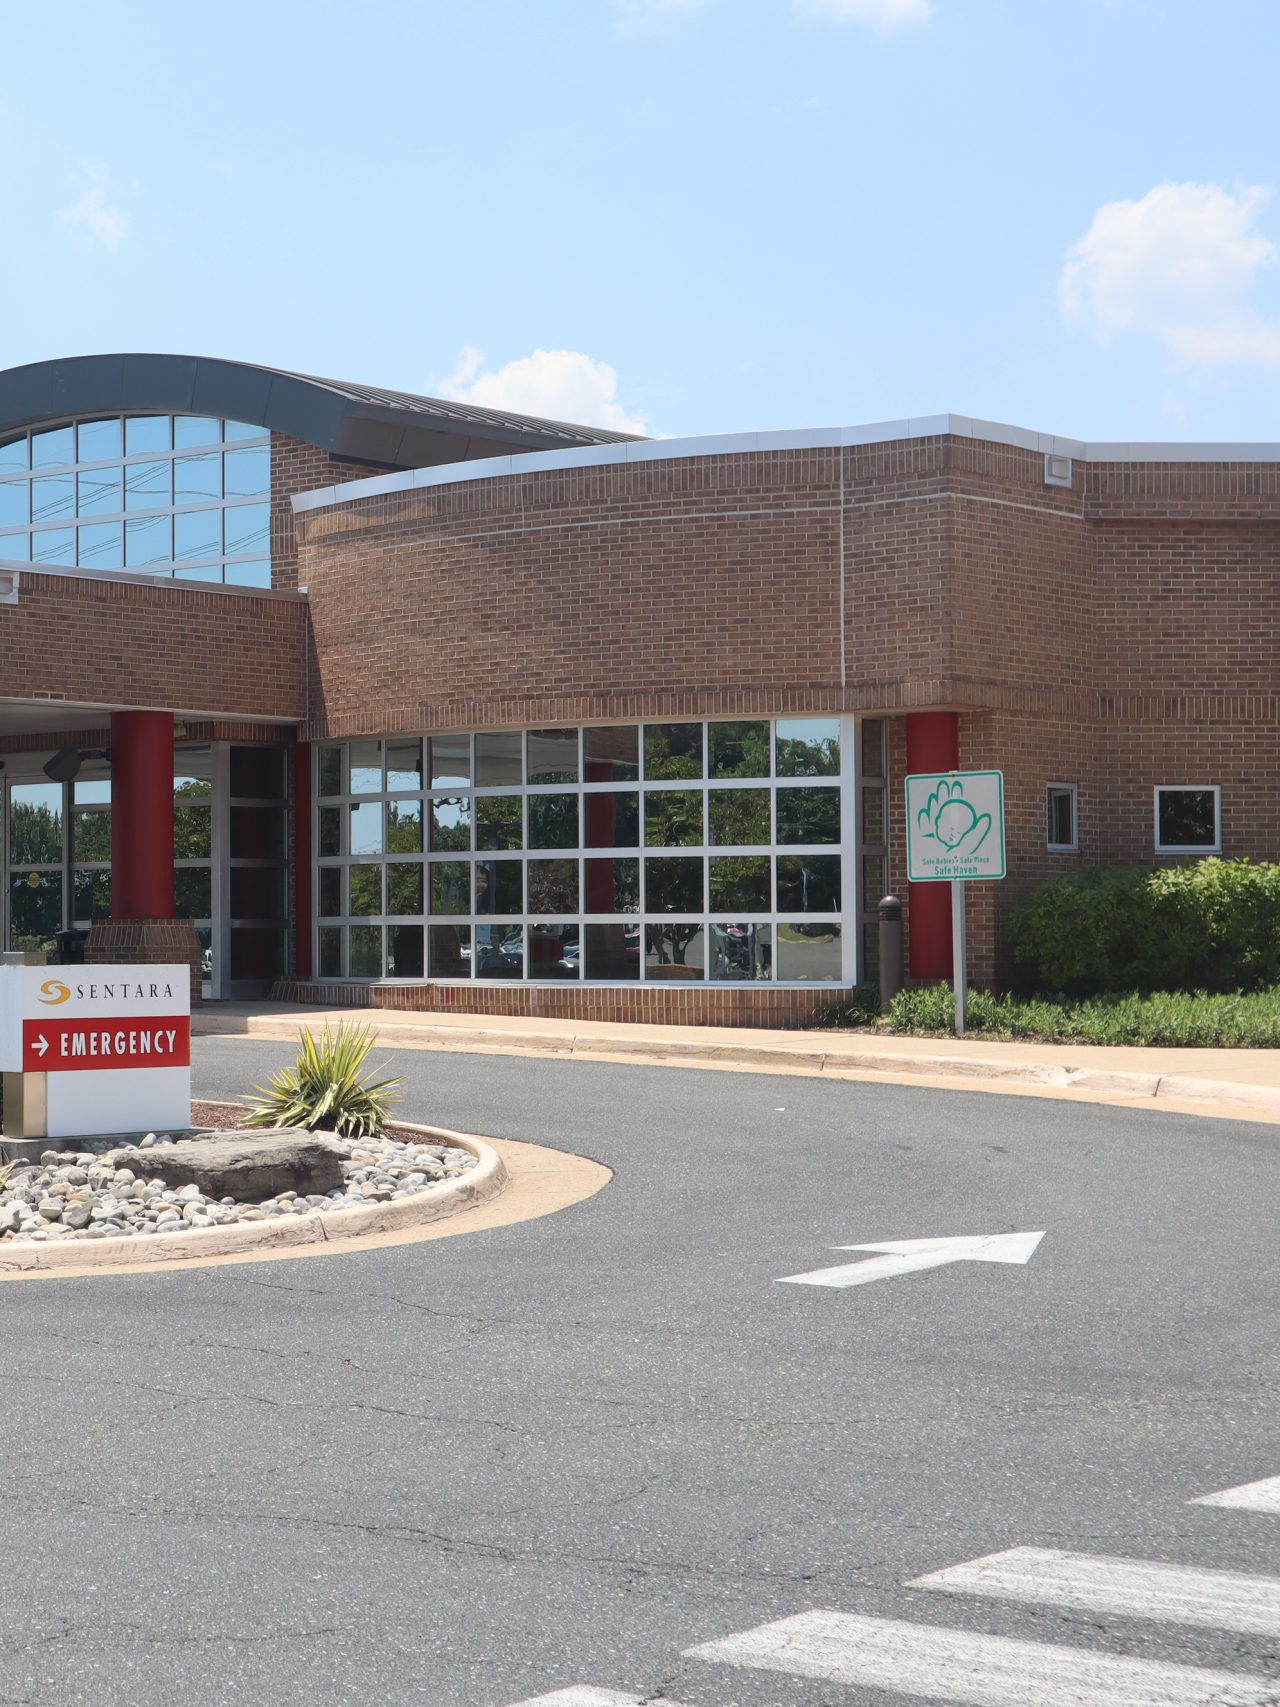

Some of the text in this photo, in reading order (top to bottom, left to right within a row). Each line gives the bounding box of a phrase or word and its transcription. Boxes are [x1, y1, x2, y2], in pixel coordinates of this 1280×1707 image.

[934, 865, 978, 875] Safe Haven
[77, 983, 173, 1000] SENTARA
[61, 1030, 177, 1057] EMERGENCY
